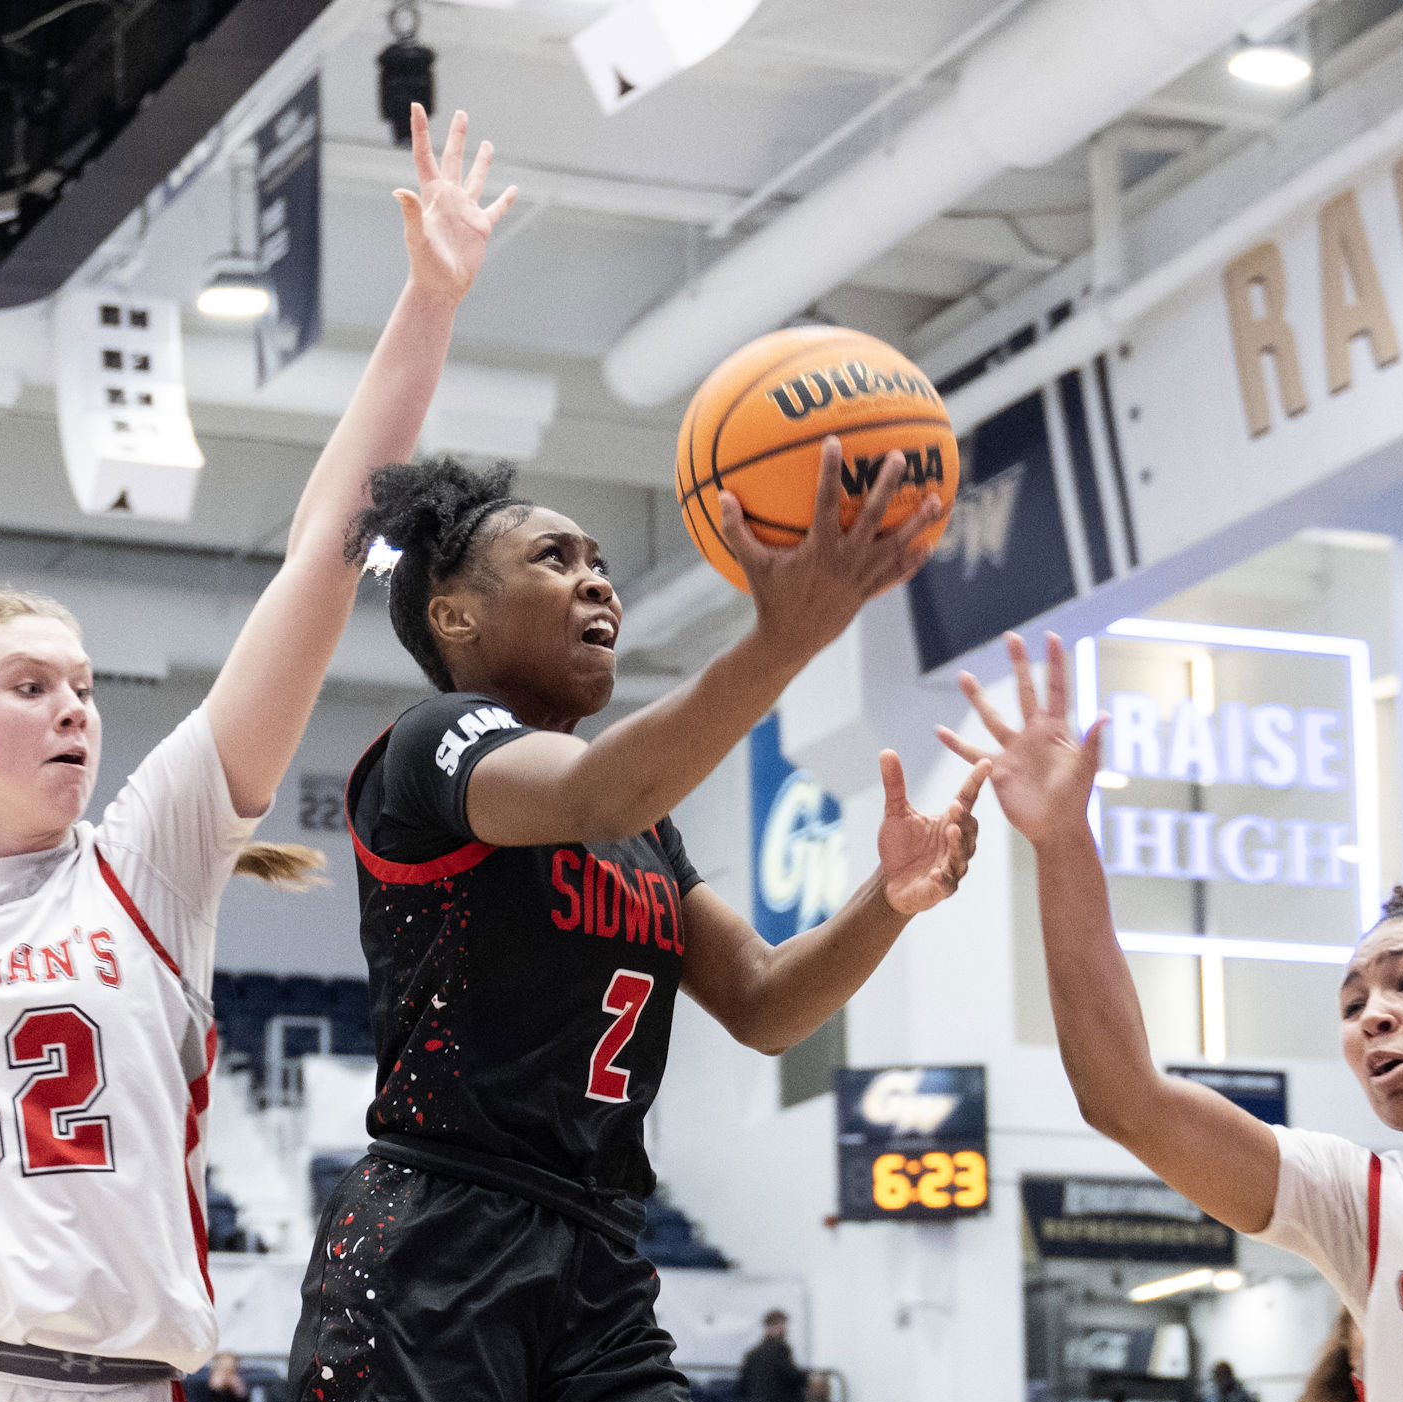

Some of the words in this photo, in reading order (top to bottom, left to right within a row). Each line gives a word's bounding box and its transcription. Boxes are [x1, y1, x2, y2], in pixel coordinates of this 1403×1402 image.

[766, 360, 940, 420] Wilson
[1107, 692, 1345, 791] RAISE
[300, 794, 343, 832] 22
[1106, 806, 1348, 888] HIGH
[551, 848, 685, 956] SIDWEL
[585, 967, 654, 1104] 2
[872, 1150, 988, 1211] 6:23
